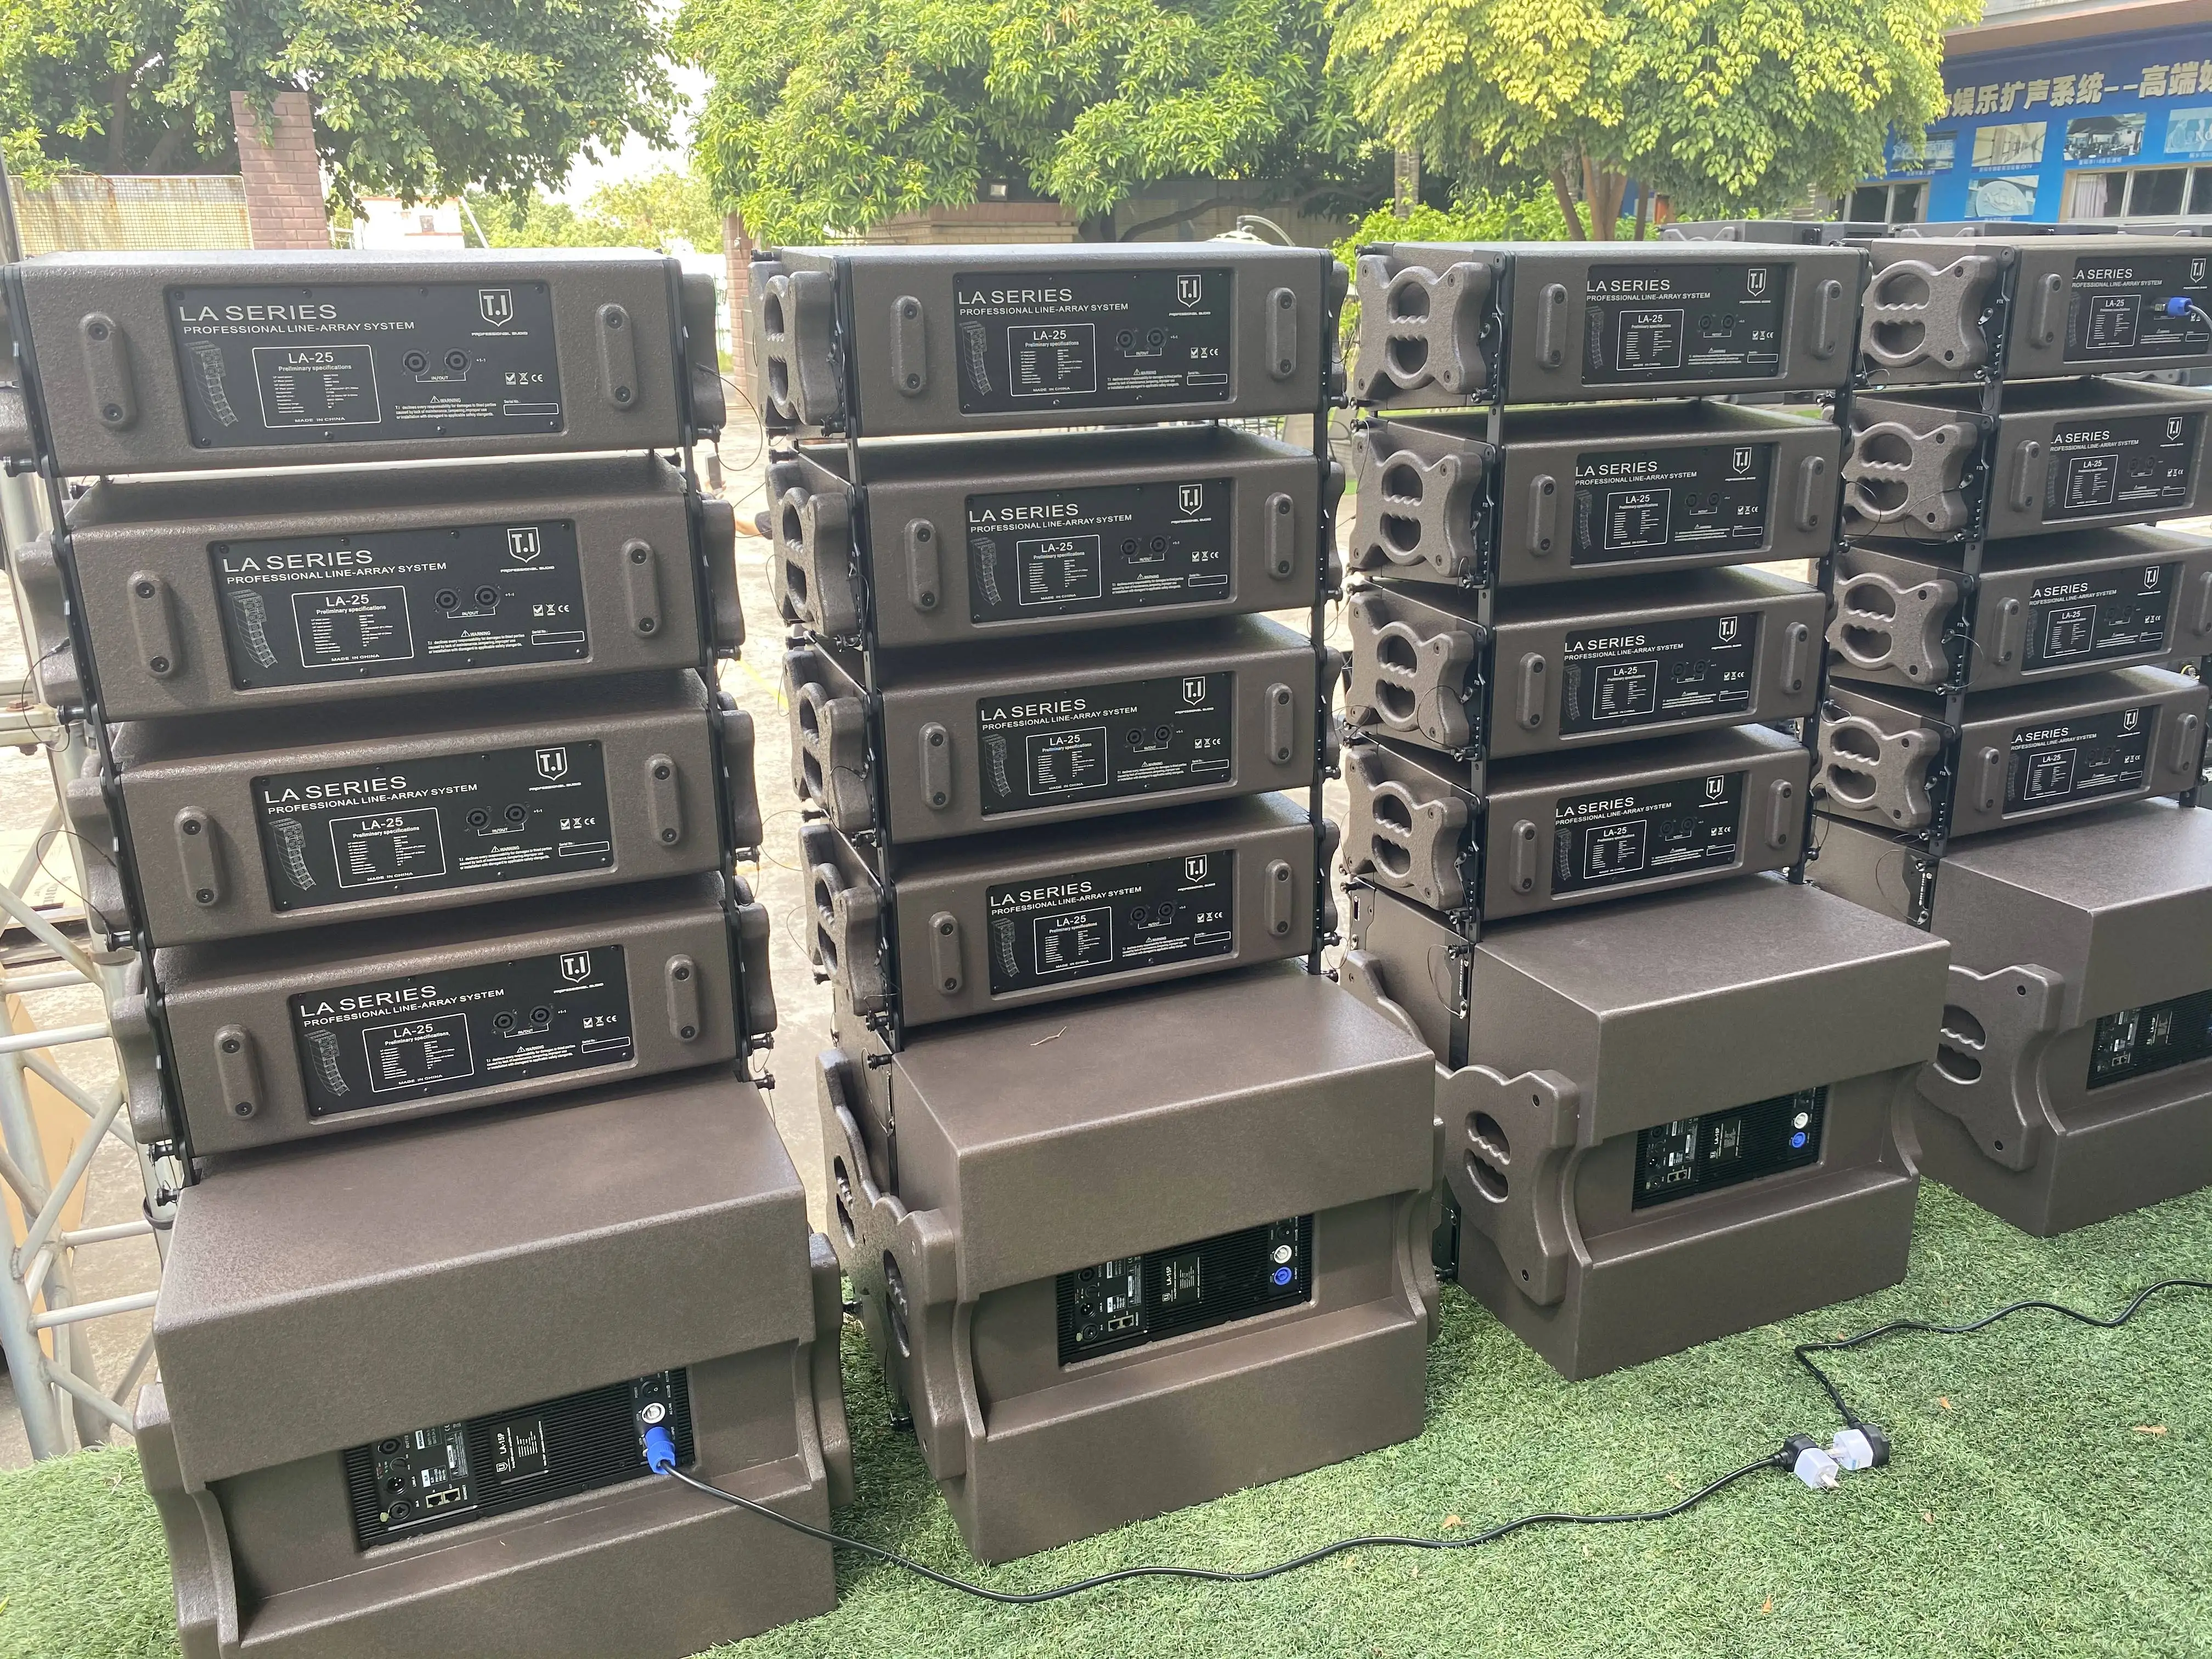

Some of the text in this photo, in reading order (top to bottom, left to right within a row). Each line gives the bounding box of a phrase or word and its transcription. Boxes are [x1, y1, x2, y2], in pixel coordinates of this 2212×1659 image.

[2073, 268, 2133, 279] A SERIES
[1587, 279, 1670, 292] LA SERIES
[958, 288, 1072, 304] LA SERIES
[179, 303, 337, 321] LA SERIES
[960, 307, 1033, 315] PROFESSIONAL
[1035, 304, 1089, 313] LINE-ARRAY
[1638, 314, 1663, 323] LA-25
[183, 321, 415, 334] PROFESSIONAL LINE-ARRAY SYSTEM
[1033, 330, 1066, 340] LA-25
[287, 351, 334, 364] LA-25
[2051, 430, 2110, 444] A SERIES
[1575, 461, 1657, 476] LA SERIES
[2083, 459, 2102, 468] LA-25
[1575, 476, 1628, 485] PROFESSIONAL
[1629, 473, 1668, 482] LINE-ARRAY
[1626, 494, 1650, 504] LA-25
[969, 503, 1078, 523] LA SERIES
[970, 514, 1132, 533] PROFESSIONAL LINE-ARRAY SYSTEM
[1041, 541, 1073, 552] LA-25
[223, 549, 373, 573] LA SERIES
[227, 562, 447, 584] PROFESSIONAL LINE-ARRAY SYSTEM
[2029, 582, 2088, 598] A SERIES
[325, 593, 370, 607] LA-25
[2029, 596, 2066, 605] ROFESSIONAL
[2066, 592, 2095, 601] LINE-ARRAY
[348, 604, 387, 613] specifications
[2062, 610, 2080, 619] LA-25
[1564, 634, 1645, 653] LA SERIES
[1564, 642, 1683, 661] PROFESSIONAL LINE-ARRAY SYSTEM
[1613, 665, 1638, 676] LA-25
[981, 698, 1086, 721] LA SERIES
[982, 707, 1137, 730] PROFESSIONAL LINE-ARRAY SYSTEM
[1049, 734, 1080, 746] LA-25
[2011, 726, 2069, 744] A SERIES
[2010, 741, 2046, 751] ROFESSIONAL
[2046, 736, 2076, 745] LINE-ARRAY
[2042, 753, 2061, 763] LA-25
[264, 775, 407, 804] LA SERIES
[267, 783, 477, 814] PROFESSIONAL LINE-ARRAY SYSTEM
[1555, 796, 1634, 817] LA SERIES
[1555, 802, 1671, 825] PROFESSIONAL LINE-ARRAY SYSTEM
[362, 816, 404, 831] LA-25
[352, 825, 420, 839] Preliminary specifications
[1603, 826, 1627, 837] LA-25
[990, 881, 1091, 906] LA SERIES
[991, 886, 1141, 915] PROFESSIONAL LINE-ARRAY SYSTEM
[1057, 914, 1086, 927] LA-25
[300, 984, 437, 1017] LA SERIES
[303, 989, 504, 1027] PROFESSIONAL LINE-ARRAY SYSTEM
[385, 1030, 449, 1046] Preliminary specifications
[393, 1023, 433, 1038] LA-25
[498, 1433, 507, 1454] LA-15P
